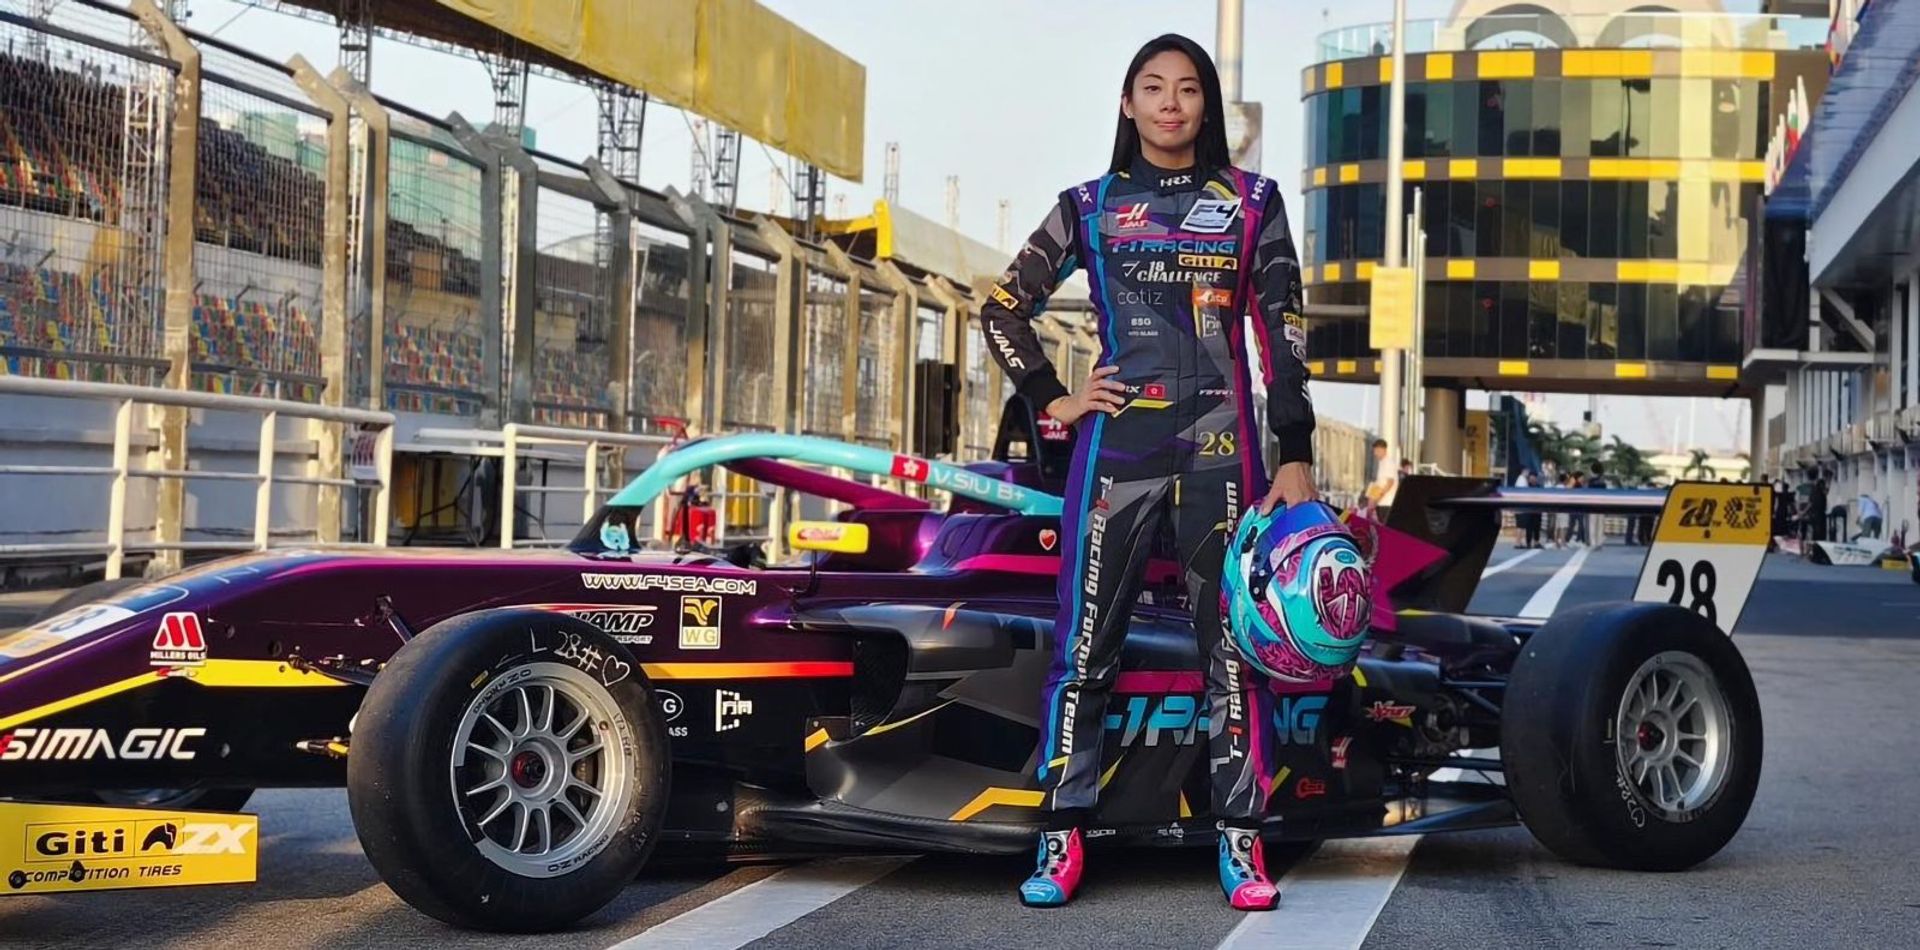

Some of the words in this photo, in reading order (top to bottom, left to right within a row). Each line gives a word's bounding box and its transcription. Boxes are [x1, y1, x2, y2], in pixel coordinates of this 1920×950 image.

[1136, 269, 1222, 283] CHALLENGE
[1199, 431, 1235, 456] 28
[1084, 513, 1107, 597] Racing
[1656, 559, 1717, 629] 28
[150, 651, 186, 660] MILLERS
[187, 651, 207, 660] OILS
[1061, 690, 1080, 755] Team
[2, 727, 207, 759] SIMAGIC
[36, 828, 124, 856] Giti
[171, 822, 256, 855] ZX
[138, 864, 182, 877] TIRES
